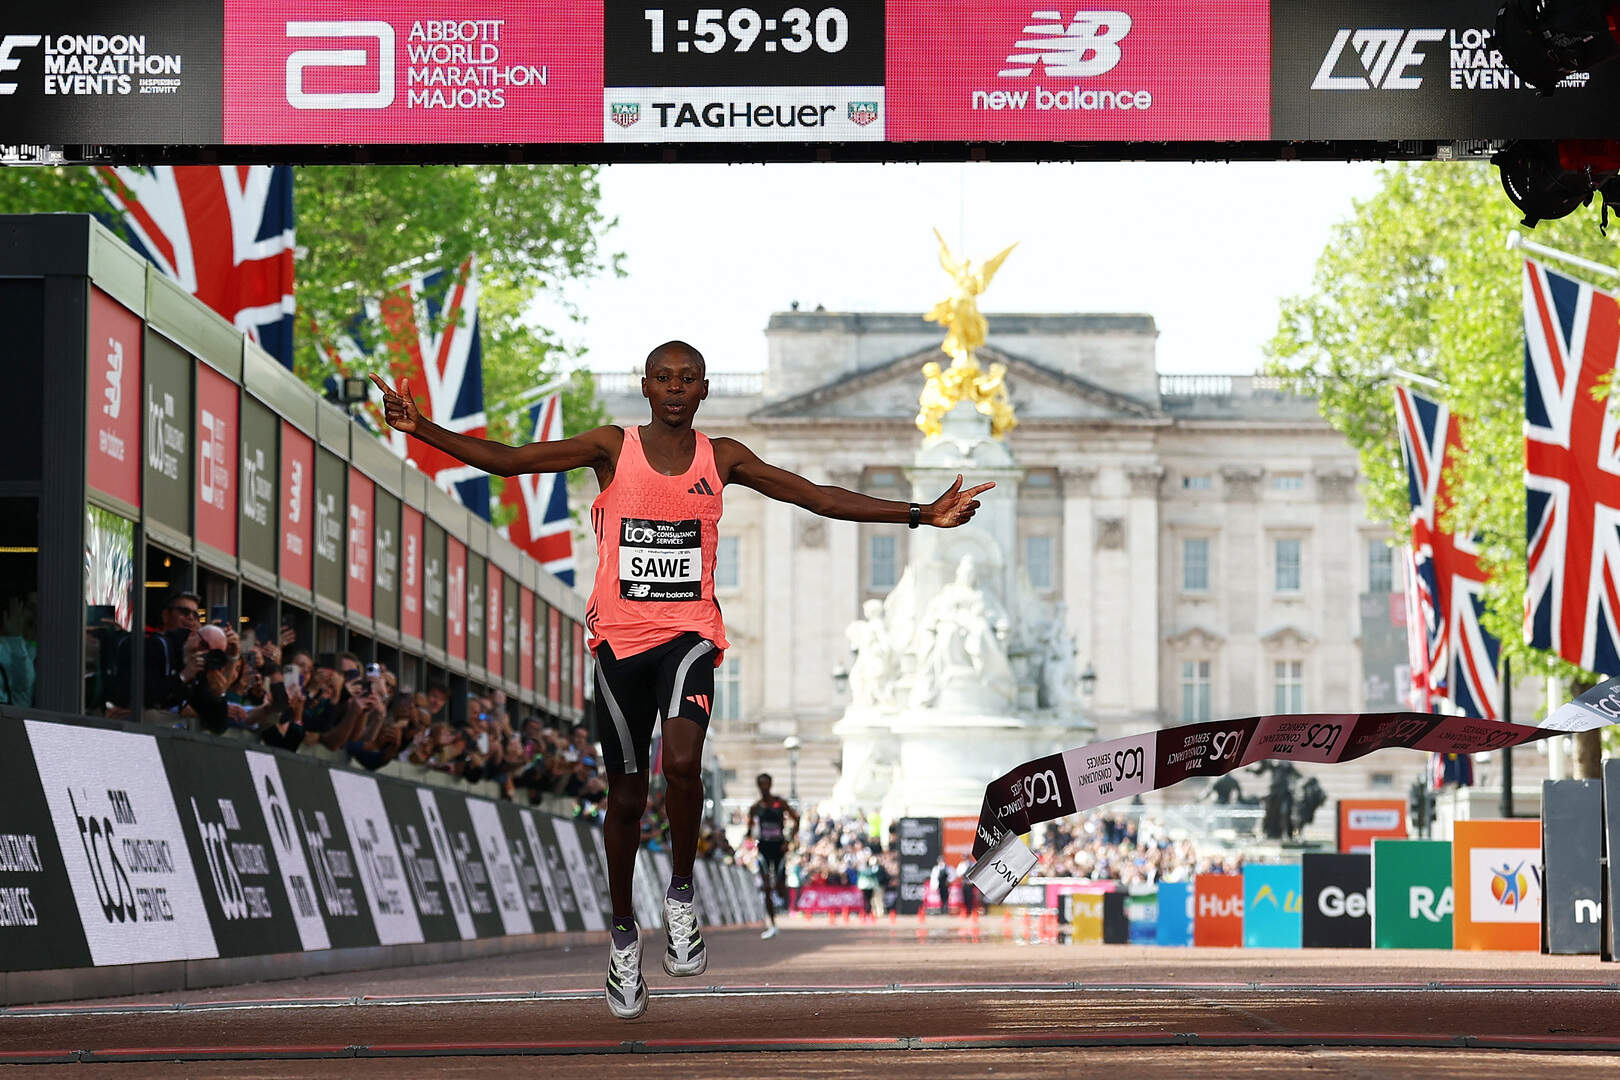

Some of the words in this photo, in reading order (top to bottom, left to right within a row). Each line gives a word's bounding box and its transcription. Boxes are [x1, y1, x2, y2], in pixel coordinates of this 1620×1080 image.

[407, 20, 505, 42] ABBOTT
[644, 9, 849, 54] 1:59:30
[45, 35, 145, 55] LONDON
[407, 43, 499, 64] WORLD
[45, 55, 181, 74] MARATHON
[1450, 49, 1508, 68] MAR
[45, 75, 131, 95] EVENTS
[139, 78, 181, 86] INSPIRING
[407, 66, 547, 86] MARATHON
[1450, 69, 1536, 89] EVENT
[139, 86, 178, 94] ACTIVITY
[407, 88, 505, 109] MAJORS
[972, 90, 1029, 110] new
[1035, 86, 1152, 110] balance
[625, 523, 654, 543] tcs
[656, 531, 697, 539] CONSULTANCY
[631, 557, 690, 577] SAWE
[666, 591, 694, 599] balance
[1184, 732, 1211, 747] SERVICES
[1210, 729, 1245, 763] tcs
[1301, 723, 1342, 756] tcs
[1086, 752, 1112, 769] SERVICES
[1115, 746, 1144, 784] tcs
[1167, 745, 1207, 765] CONSULTANCY
[1185, 758, 1202, 771] TATA
[1078, 767, 1112, 787] CONSULTANCY
[1023, 769, 1063, 808] tcs
[1098, 782, 1114, 796] TATA
[107, 789, 137, 824] TATA
[68, 787, 137, 923] tcs
[122, 838, 174, 873] CONSULTANCY
[191, 796, 249, 920] tcs
[136, 888, 174, 922] SERVICES
